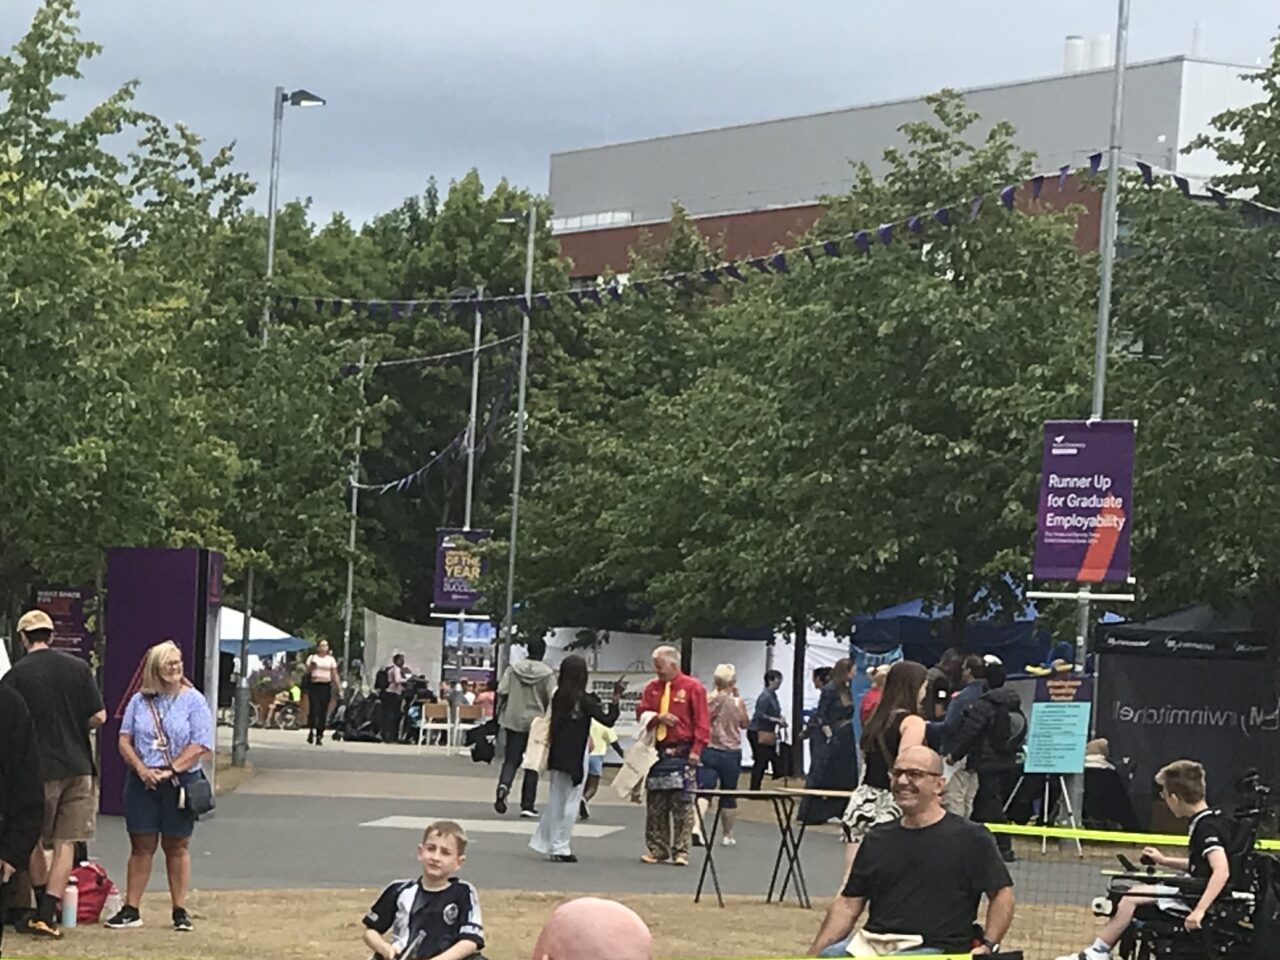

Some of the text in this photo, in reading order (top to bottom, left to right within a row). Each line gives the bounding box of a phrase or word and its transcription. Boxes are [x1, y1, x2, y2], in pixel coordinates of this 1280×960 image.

[1048, 474, 1111, 491] Runner Up
[1047, 493, 1123, 508] for Graduate
[1045, 513, 1126, 531] Employability
[445, 566, 481, 578] YEAR
